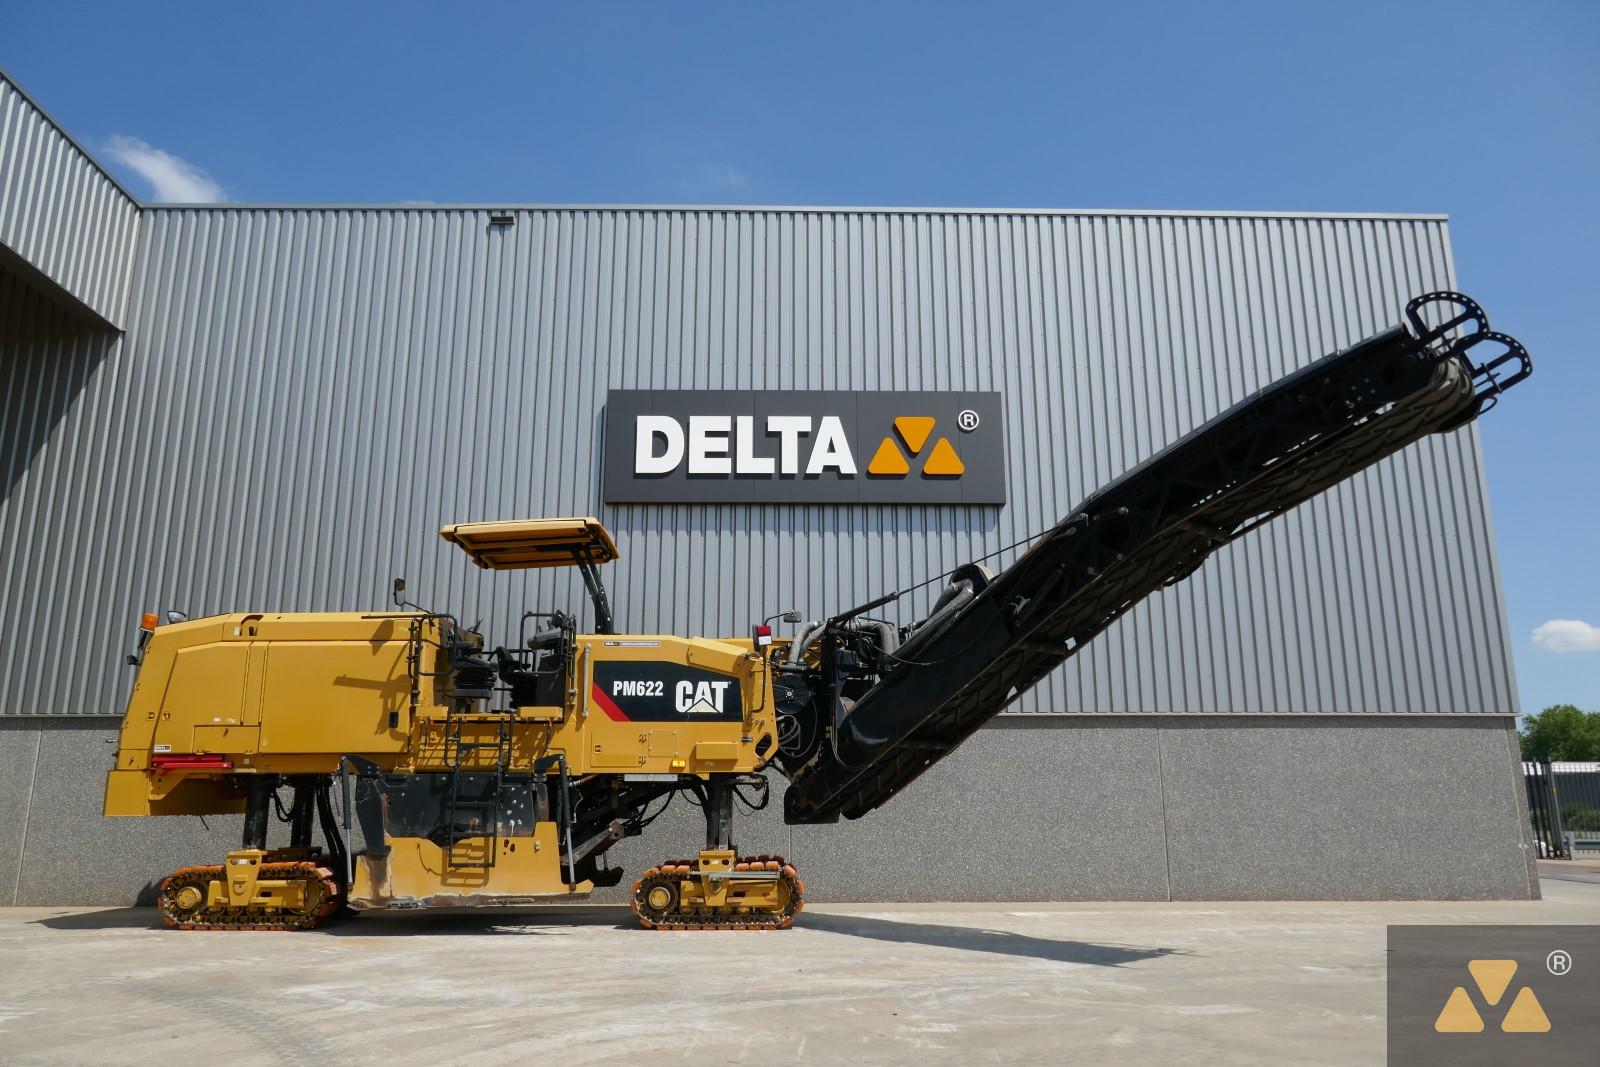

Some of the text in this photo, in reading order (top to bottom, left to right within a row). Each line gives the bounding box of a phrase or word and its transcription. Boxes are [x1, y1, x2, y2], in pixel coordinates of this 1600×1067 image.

[635, 415, 858, 474] DELTA
[613, 680, 729, 713] PM622 CAT
